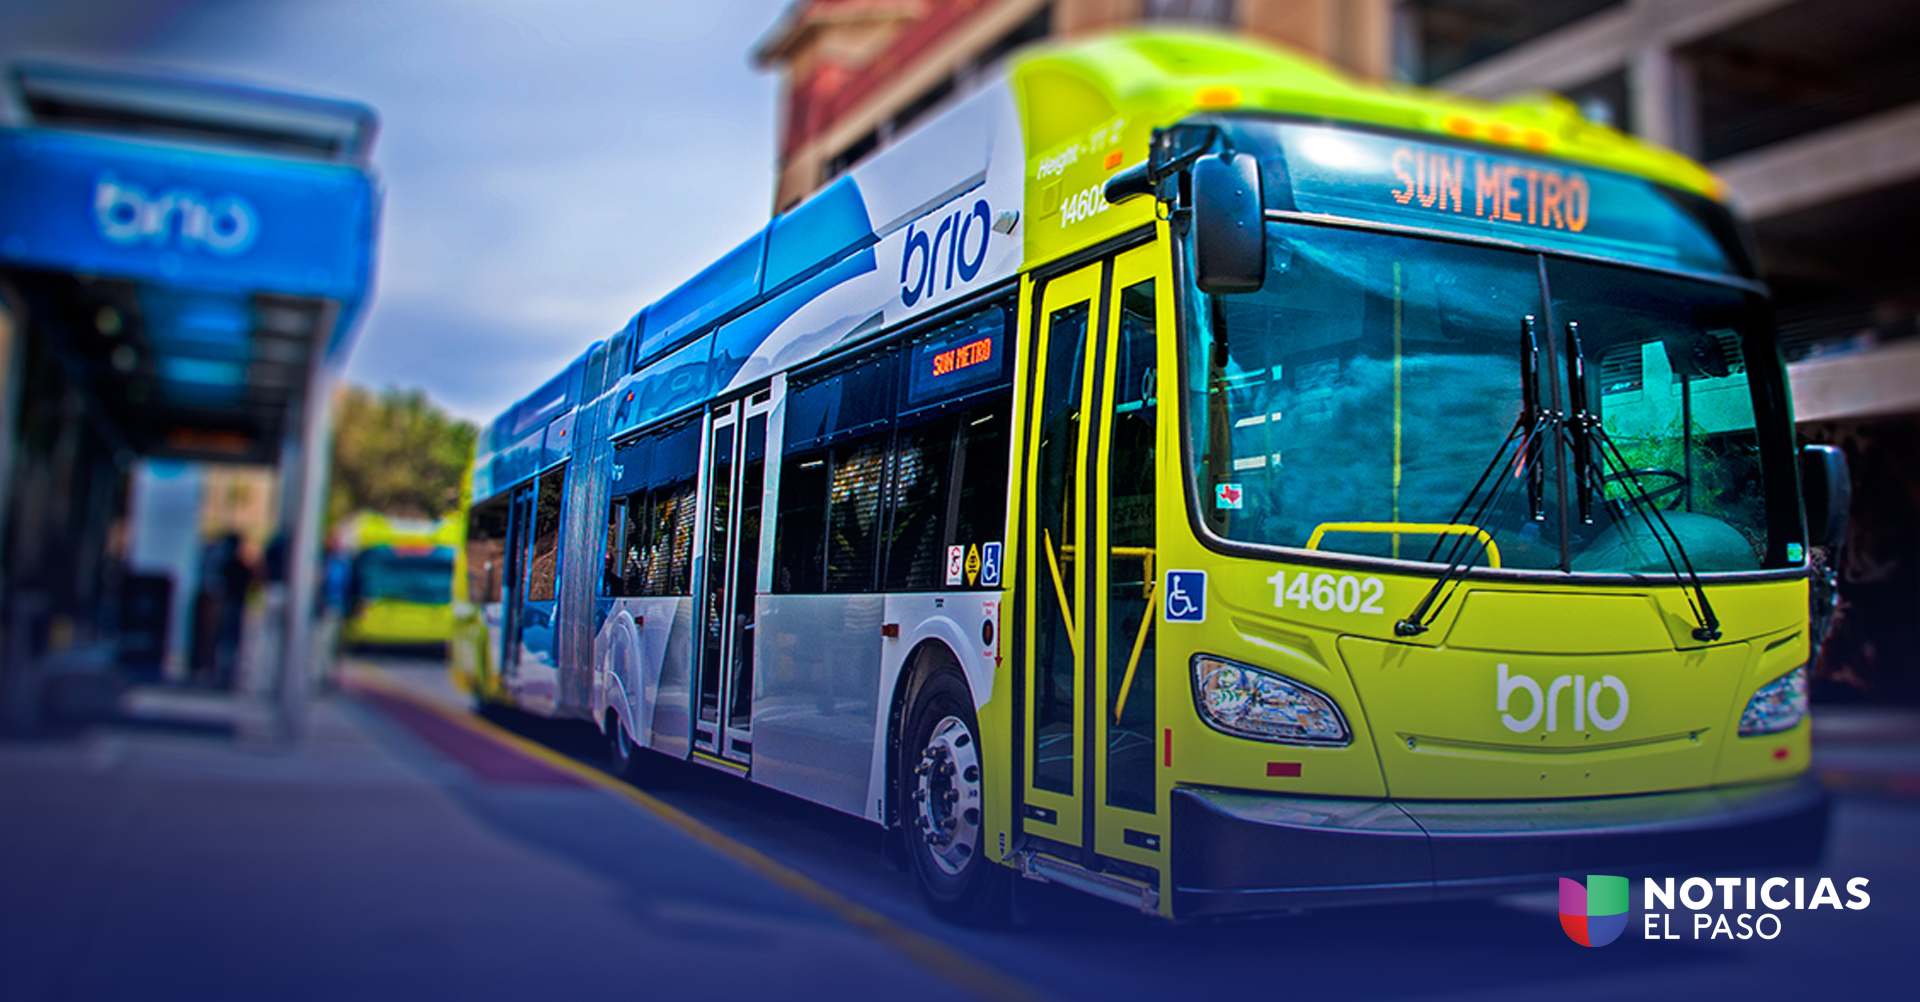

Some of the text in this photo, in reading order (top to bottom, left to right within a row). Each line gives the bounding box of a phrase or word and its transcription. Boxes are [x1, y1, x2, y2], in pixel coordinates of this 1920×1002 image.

[1036, 142, 1080, 181] Height
[1391, 147, 1590, 233] SUN METRO
[94, 171, 256, 253] brio
[900, 199, 991, 308] brio
[932, 337, 992, 377] SUN METRO
[1266, 570, 1384, 615] 14602
[1497, 663, 1630, 733] brio
